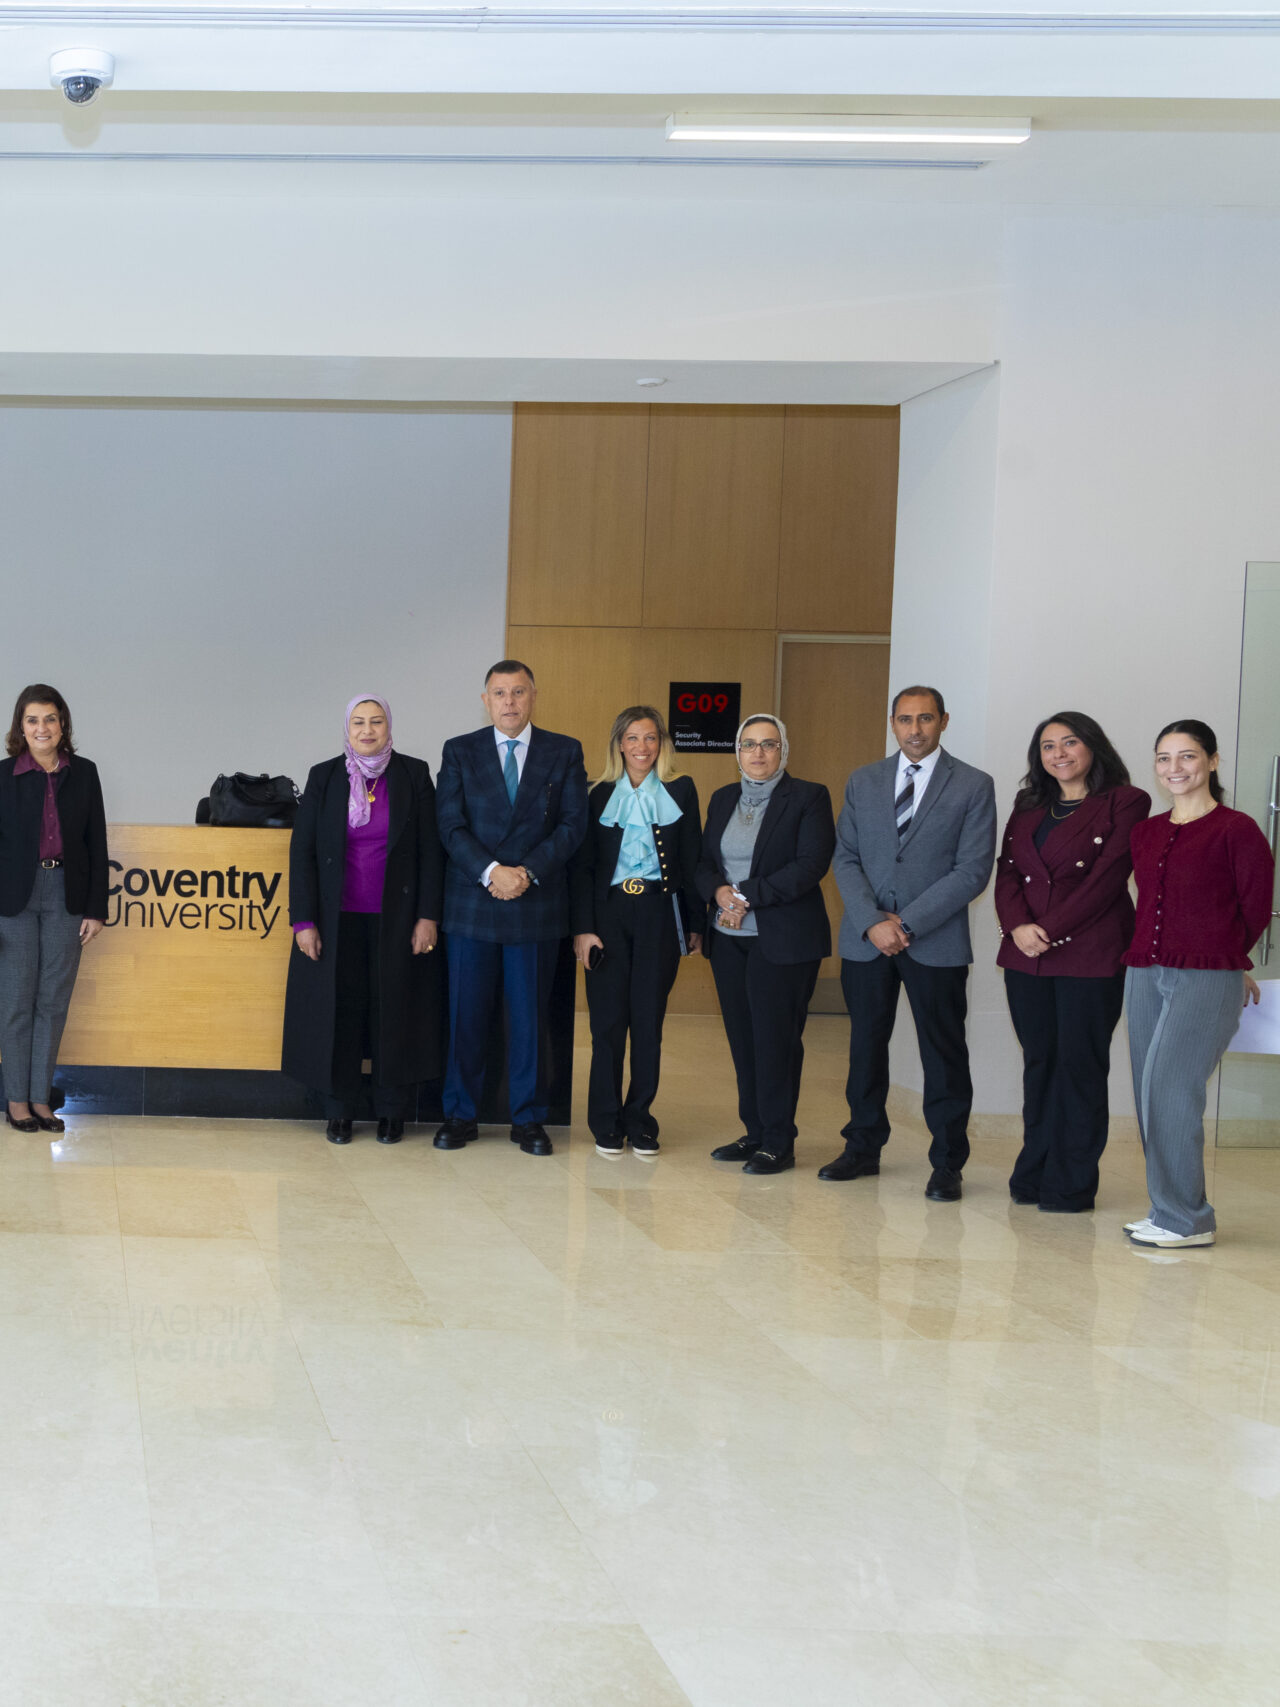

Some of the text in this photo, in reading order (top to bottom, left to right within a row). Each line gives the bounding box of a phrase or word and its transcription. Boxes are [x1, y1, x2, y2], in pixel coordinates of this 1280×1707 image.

[677, 693, 728, 713] G09
[675, 731, 701, 740] Security
[707, 740, 734, 748] Director
